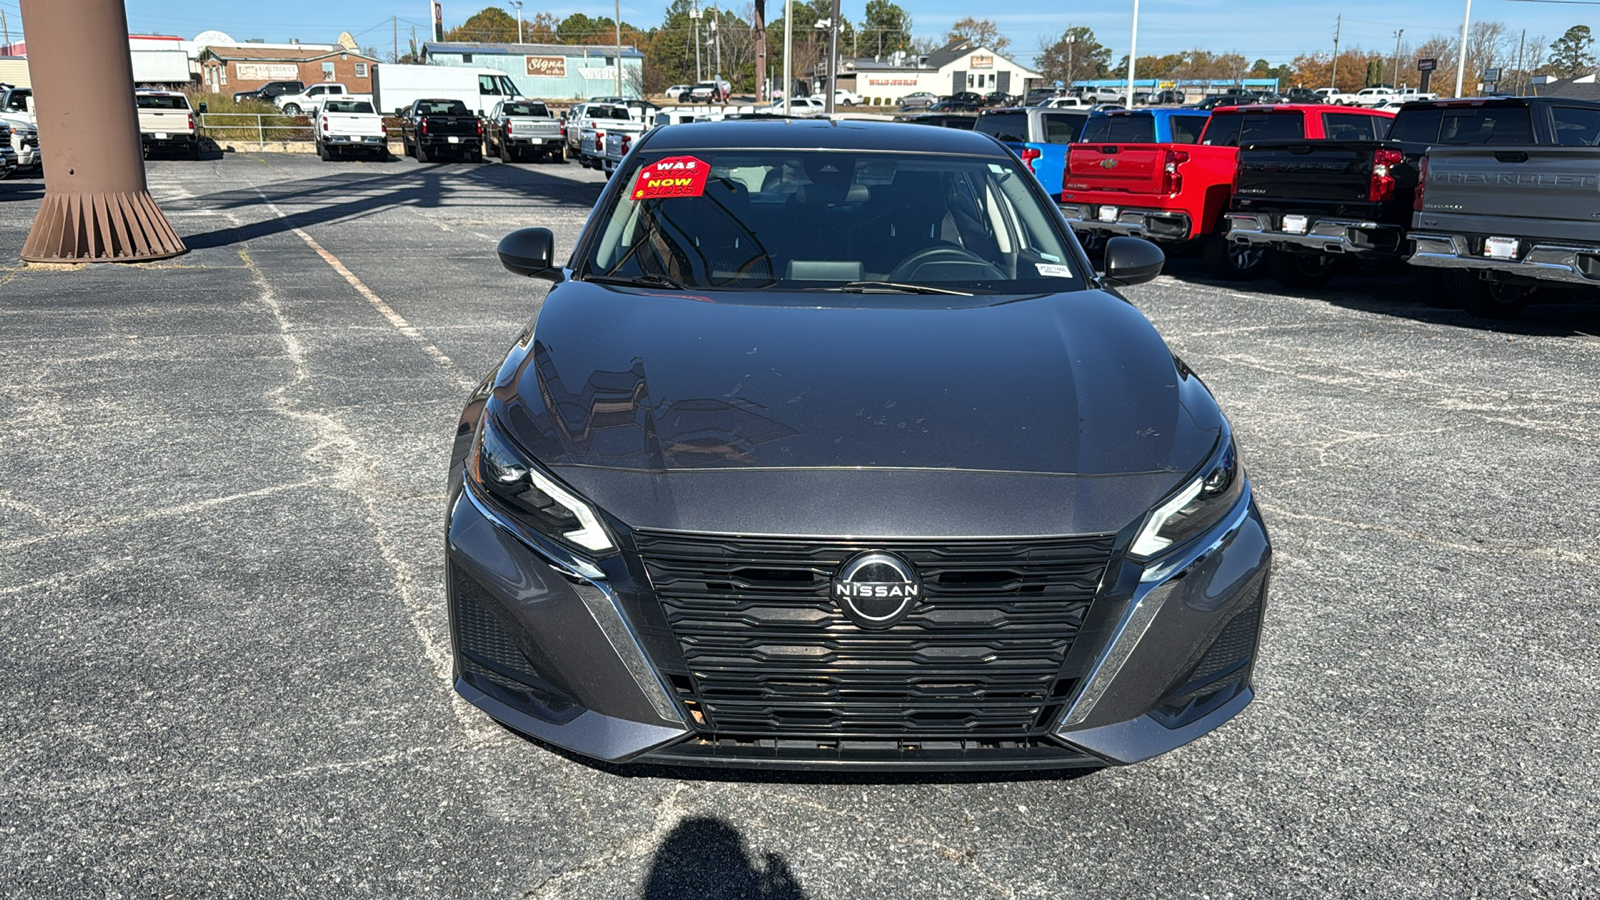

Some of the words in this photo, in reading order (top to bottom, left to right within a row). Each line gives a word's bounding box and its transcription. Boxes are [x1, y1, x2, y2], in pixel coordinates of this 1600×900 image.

[528, 58, 563, 72] Signs
[657, 162, 696, 171] WAS
[647, 178, 692, 187] NOW
[836, 584, 918, 597] NISSAN
